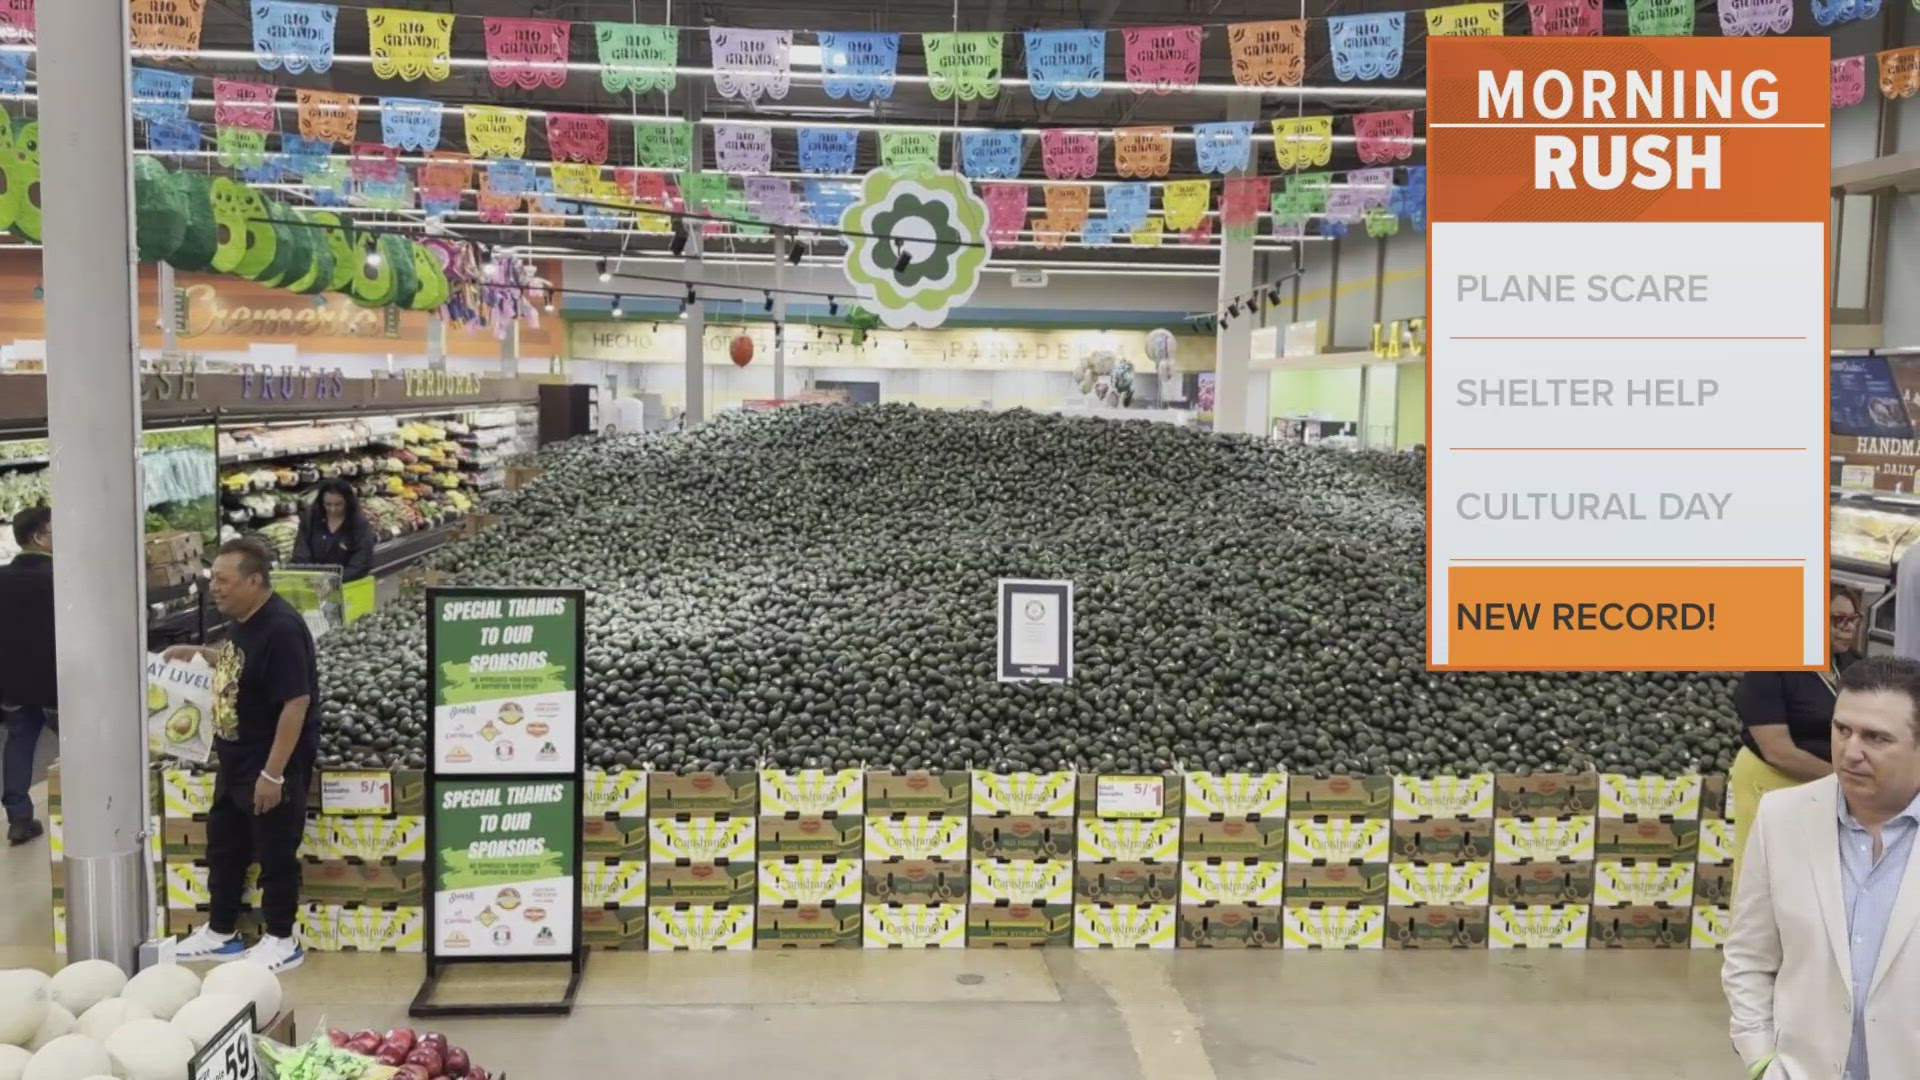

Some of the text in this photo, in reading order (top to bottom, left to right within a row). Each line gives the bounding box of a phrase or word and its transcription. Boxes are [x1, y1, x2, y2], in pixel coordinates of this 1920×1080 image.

[149, 0, 177, 13] RIO
[1555, 7, 1580, 19] RIO
[283, 12, 310, 27] RIO
[1454, 16, 1479, 29] RIO
[267, 25, 324, 41] GRANDE
[398, 21, 424, 35] RIO
[1354, 24, 1380, 37] RIO
[514, 29, 541, 42] RIO
[624, 34, 651, 47] RIO
[1256, 31, 1281, 44] RIO
[383, 35, 440, 50] GRANDE
[500, 42, 557, 56] GRANDE
[739, 40, 765, 52] RIO
[848, 41, 873, 53] RIO
[952, 42, 977, 55] RIO
[1053, 41, 1078, 54] RIO
[1151, 36, 1175, 50] RIO
[1343, 36, 1392, 49] GRANDE
[611, 49, 666, 62] GRANDE
[1137, 50, 1189, 62] GRANDE
[1243, 44, 1295, 57] GRANDE
[725, 54, 779, 67] GRANDE
[939, 55, 991, 68] GRANDE
[1040, 54, 1092, 67] GRANDE
[736, 132, 756, 141] RIO
[593, 332, 652, 349] HECHO
[241, 363, 343, 399] FRUTAS
[403, 368, 480, 397] VERDURAS
[1883, 463, 1916, 477] DAILY
[442, 597, 566, 622] SPECIAL THANKS
[480, 624, 534, 646] TO OUR
[469, 651, 548, 673] SPONSORS
[442, 784, 564, 809] SPECIAL THANKS
[480, 812, 532, 833] TO OUR
[468, 837, 546, 859] SPONSORS
[225, 1032, 249, 1080] 59
